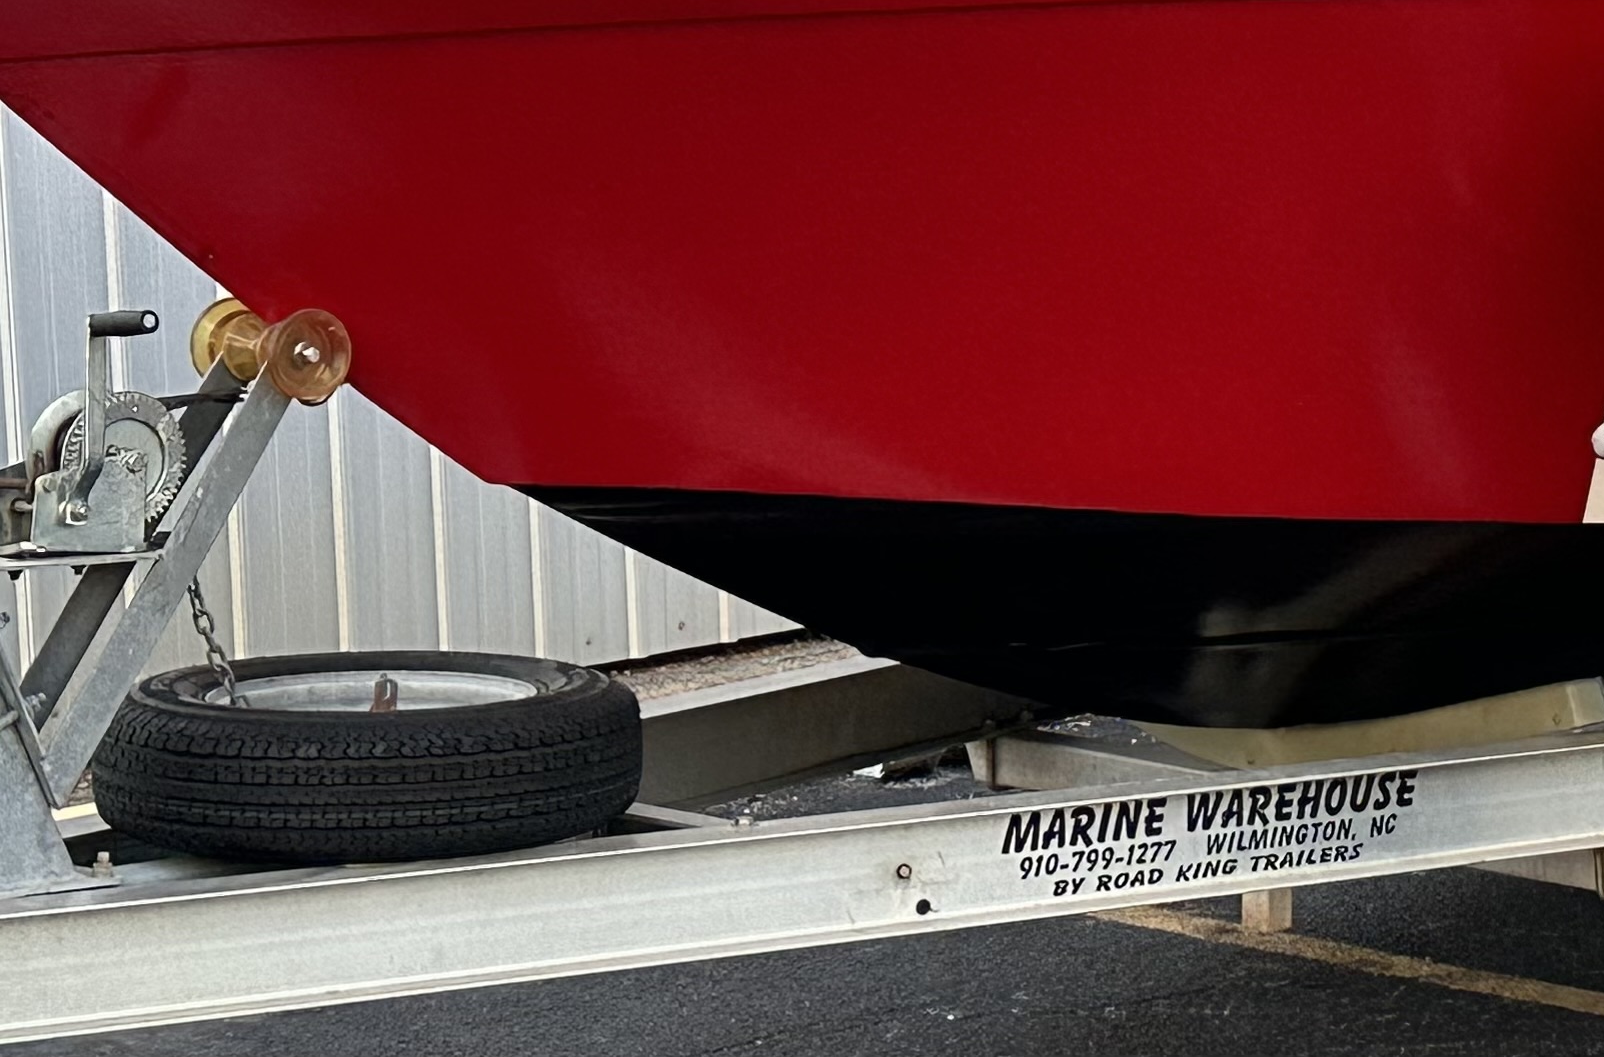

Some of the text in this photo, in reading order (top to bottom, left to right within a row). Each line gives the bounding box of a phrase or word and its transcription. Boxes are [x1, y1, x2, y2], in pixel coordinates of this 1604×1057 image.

[1001, 770, 1419, 855] MARINE WAREHOUSE
[1019, 839, 1178, 881] 910-799-1277
[1369, 812, 1399, 838] NC
[1053, 842, 1365, 898] BY ROAD KING TRAILERS
